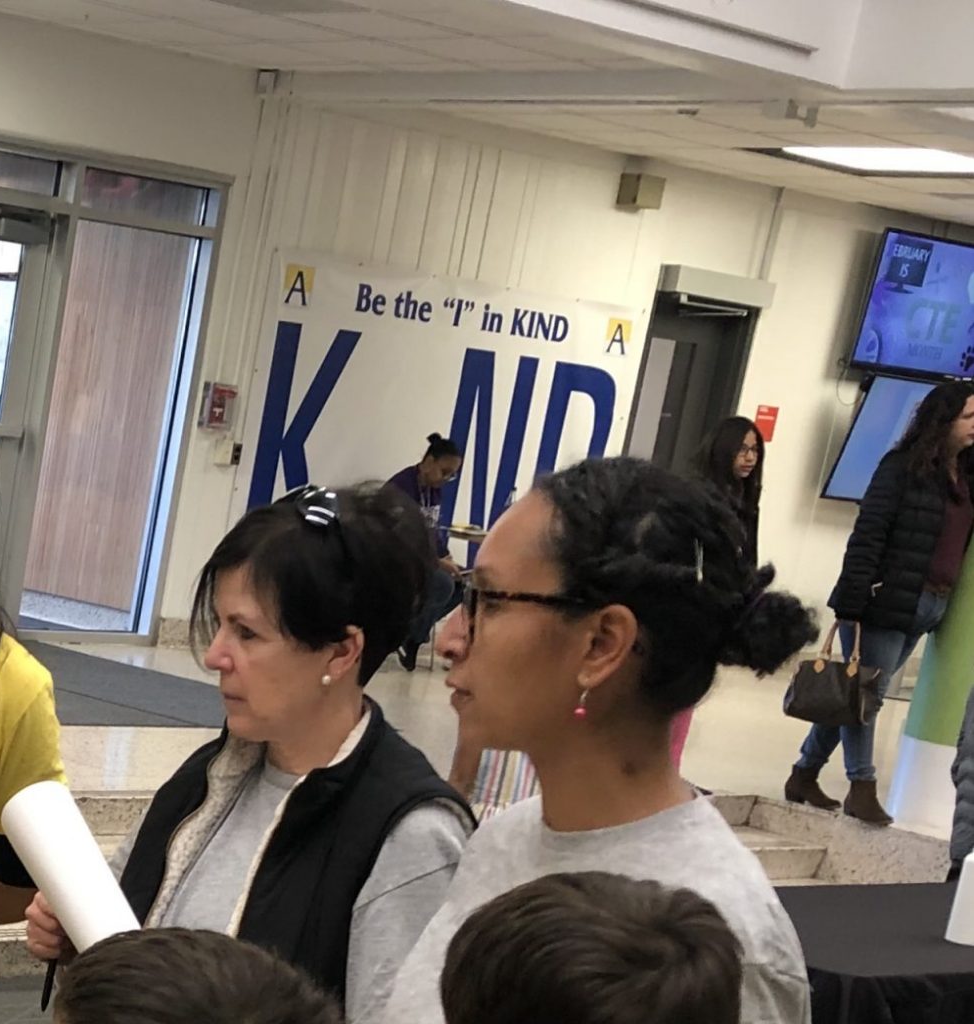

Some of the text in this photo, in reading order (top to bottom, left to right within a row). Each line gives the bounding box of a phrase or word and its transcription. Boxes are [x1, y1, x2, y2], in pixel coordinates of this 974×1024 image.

[284, 270, 307, 307] A
[355, 283, 386, 316] Be
[394, 291, 432, 322] the
[481, 303, 503, 333] in
[510, 308, 569, 343] KIND
[606, 323, 626, 356] A
